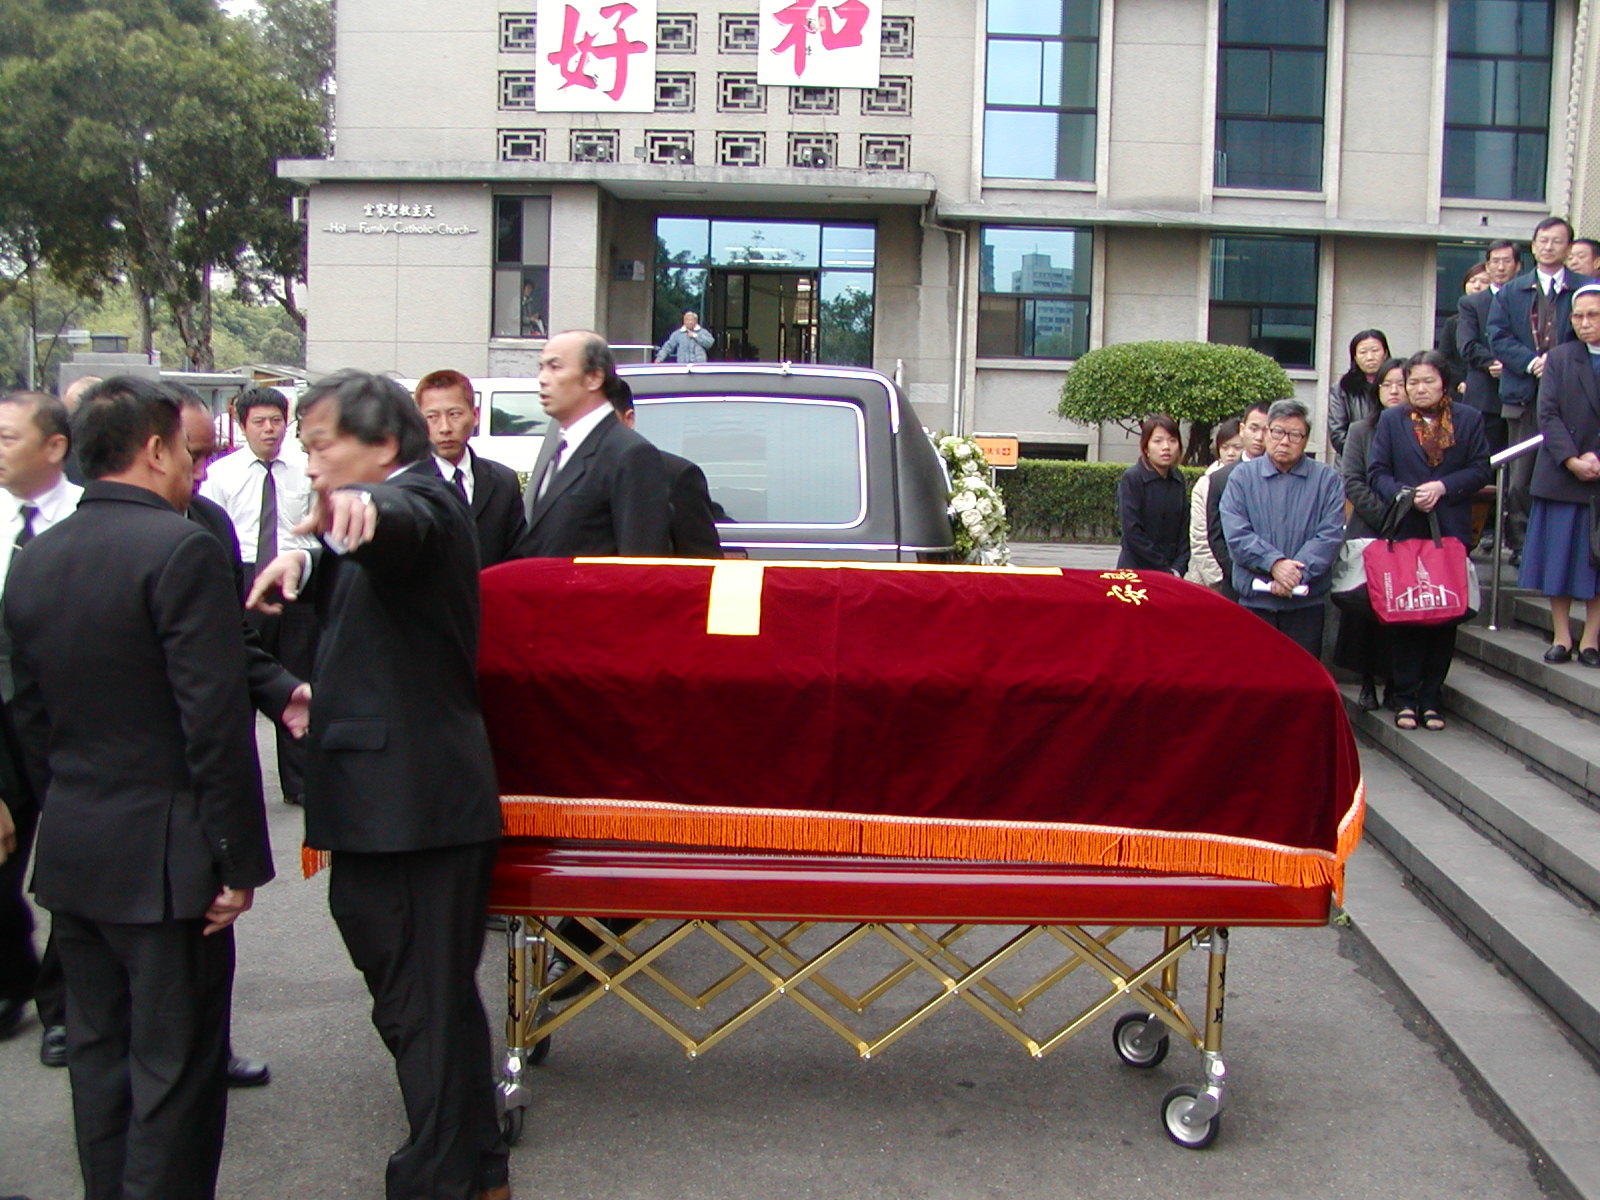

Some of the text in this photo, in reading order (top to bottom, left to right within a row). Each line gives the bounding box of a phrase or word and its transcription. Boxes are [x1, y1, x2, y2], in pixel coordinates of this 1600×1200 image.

[547, 2, 648, 102] 好
[770, 0, 870, 80] 和
[359, 221, 389, 235] Family
[393, 221, 434, 234] Catholic
[437, 223, 470, 234] Church
